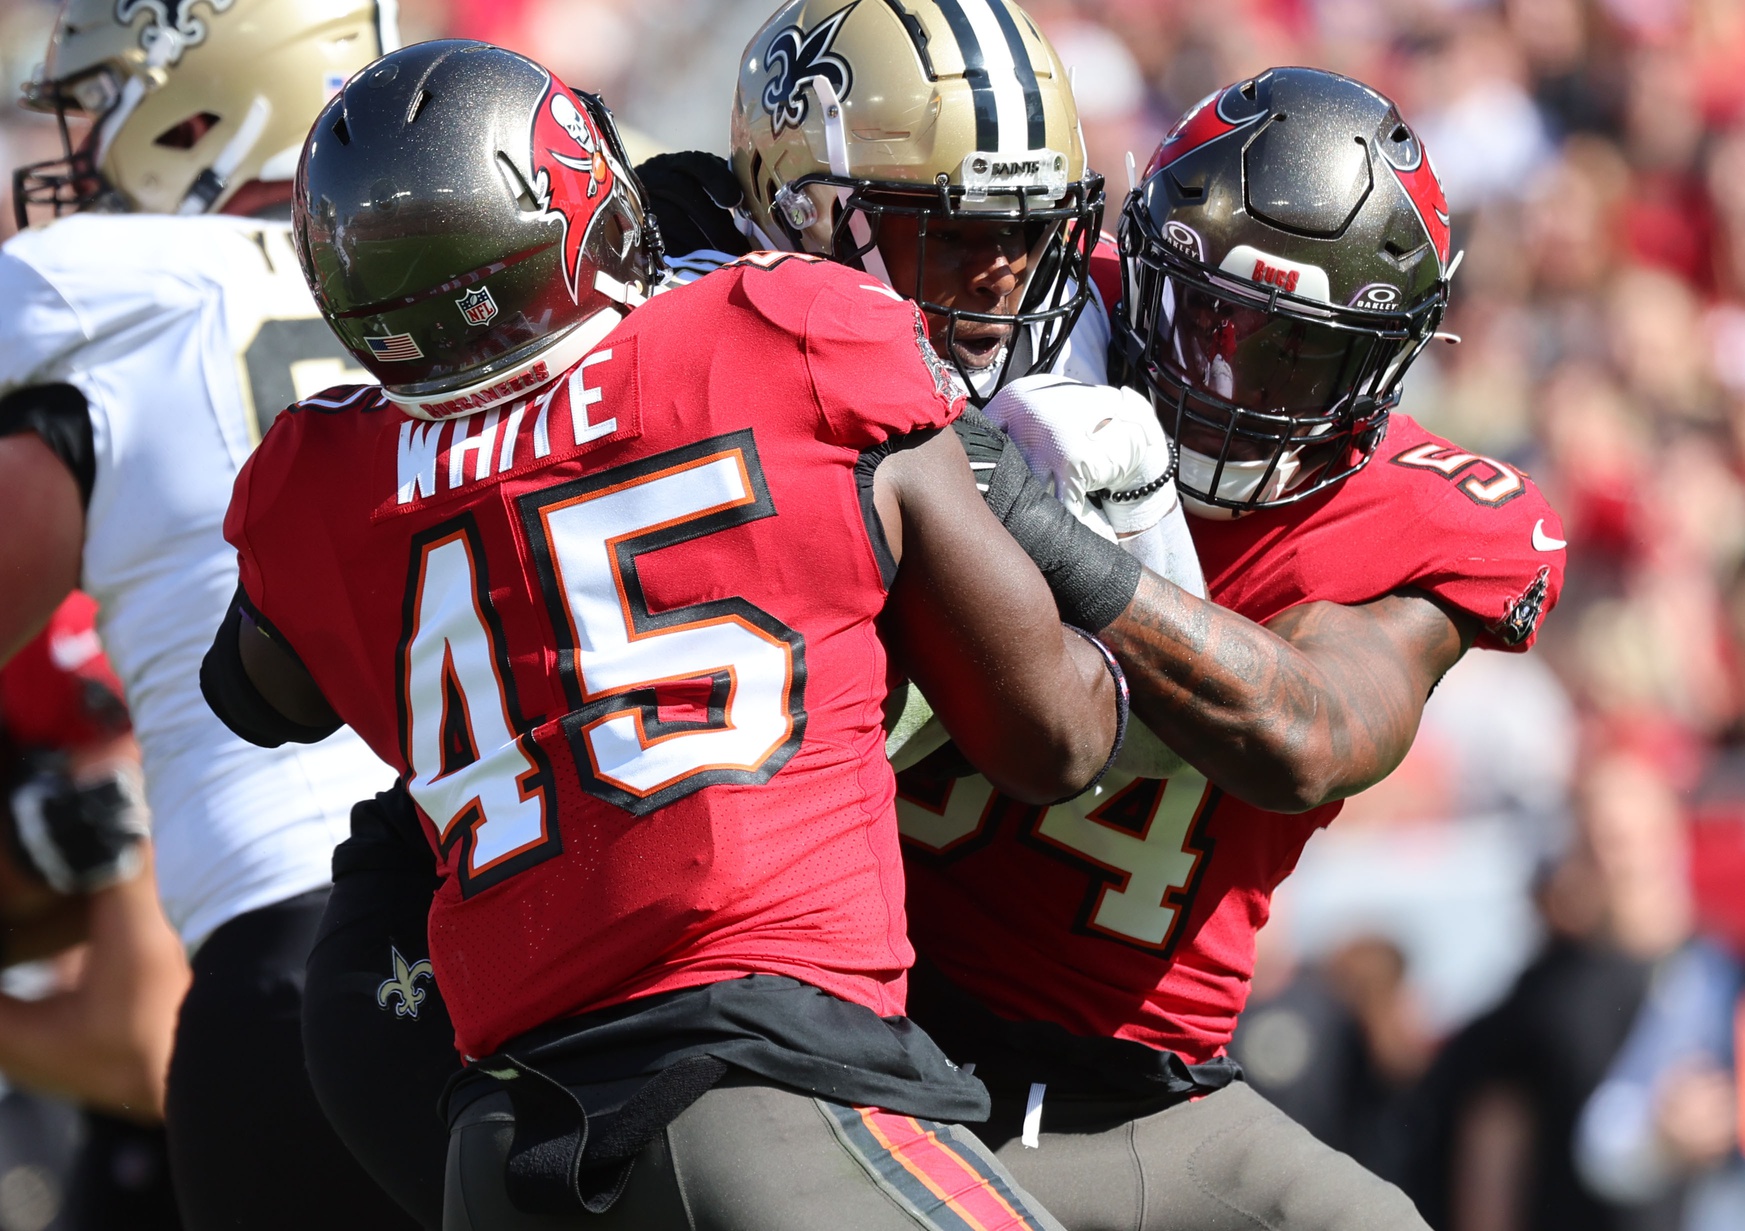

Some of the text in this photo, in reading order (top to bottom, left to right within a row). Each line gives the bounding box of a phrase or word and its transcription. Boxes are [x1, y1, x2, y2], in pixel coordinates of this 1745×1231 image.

[992, 161, 1039, 176] SAINTS
[467, 302, 494, 322] NFL
[1356, 301, 1397, 310] OAKLEY
[419, 360, 550, 419] BUCCANEERS
[398, 349, 617, 504] WHITE
[1388, 441, 1531, 509] 5
[397, 427, 808, 900] 45
